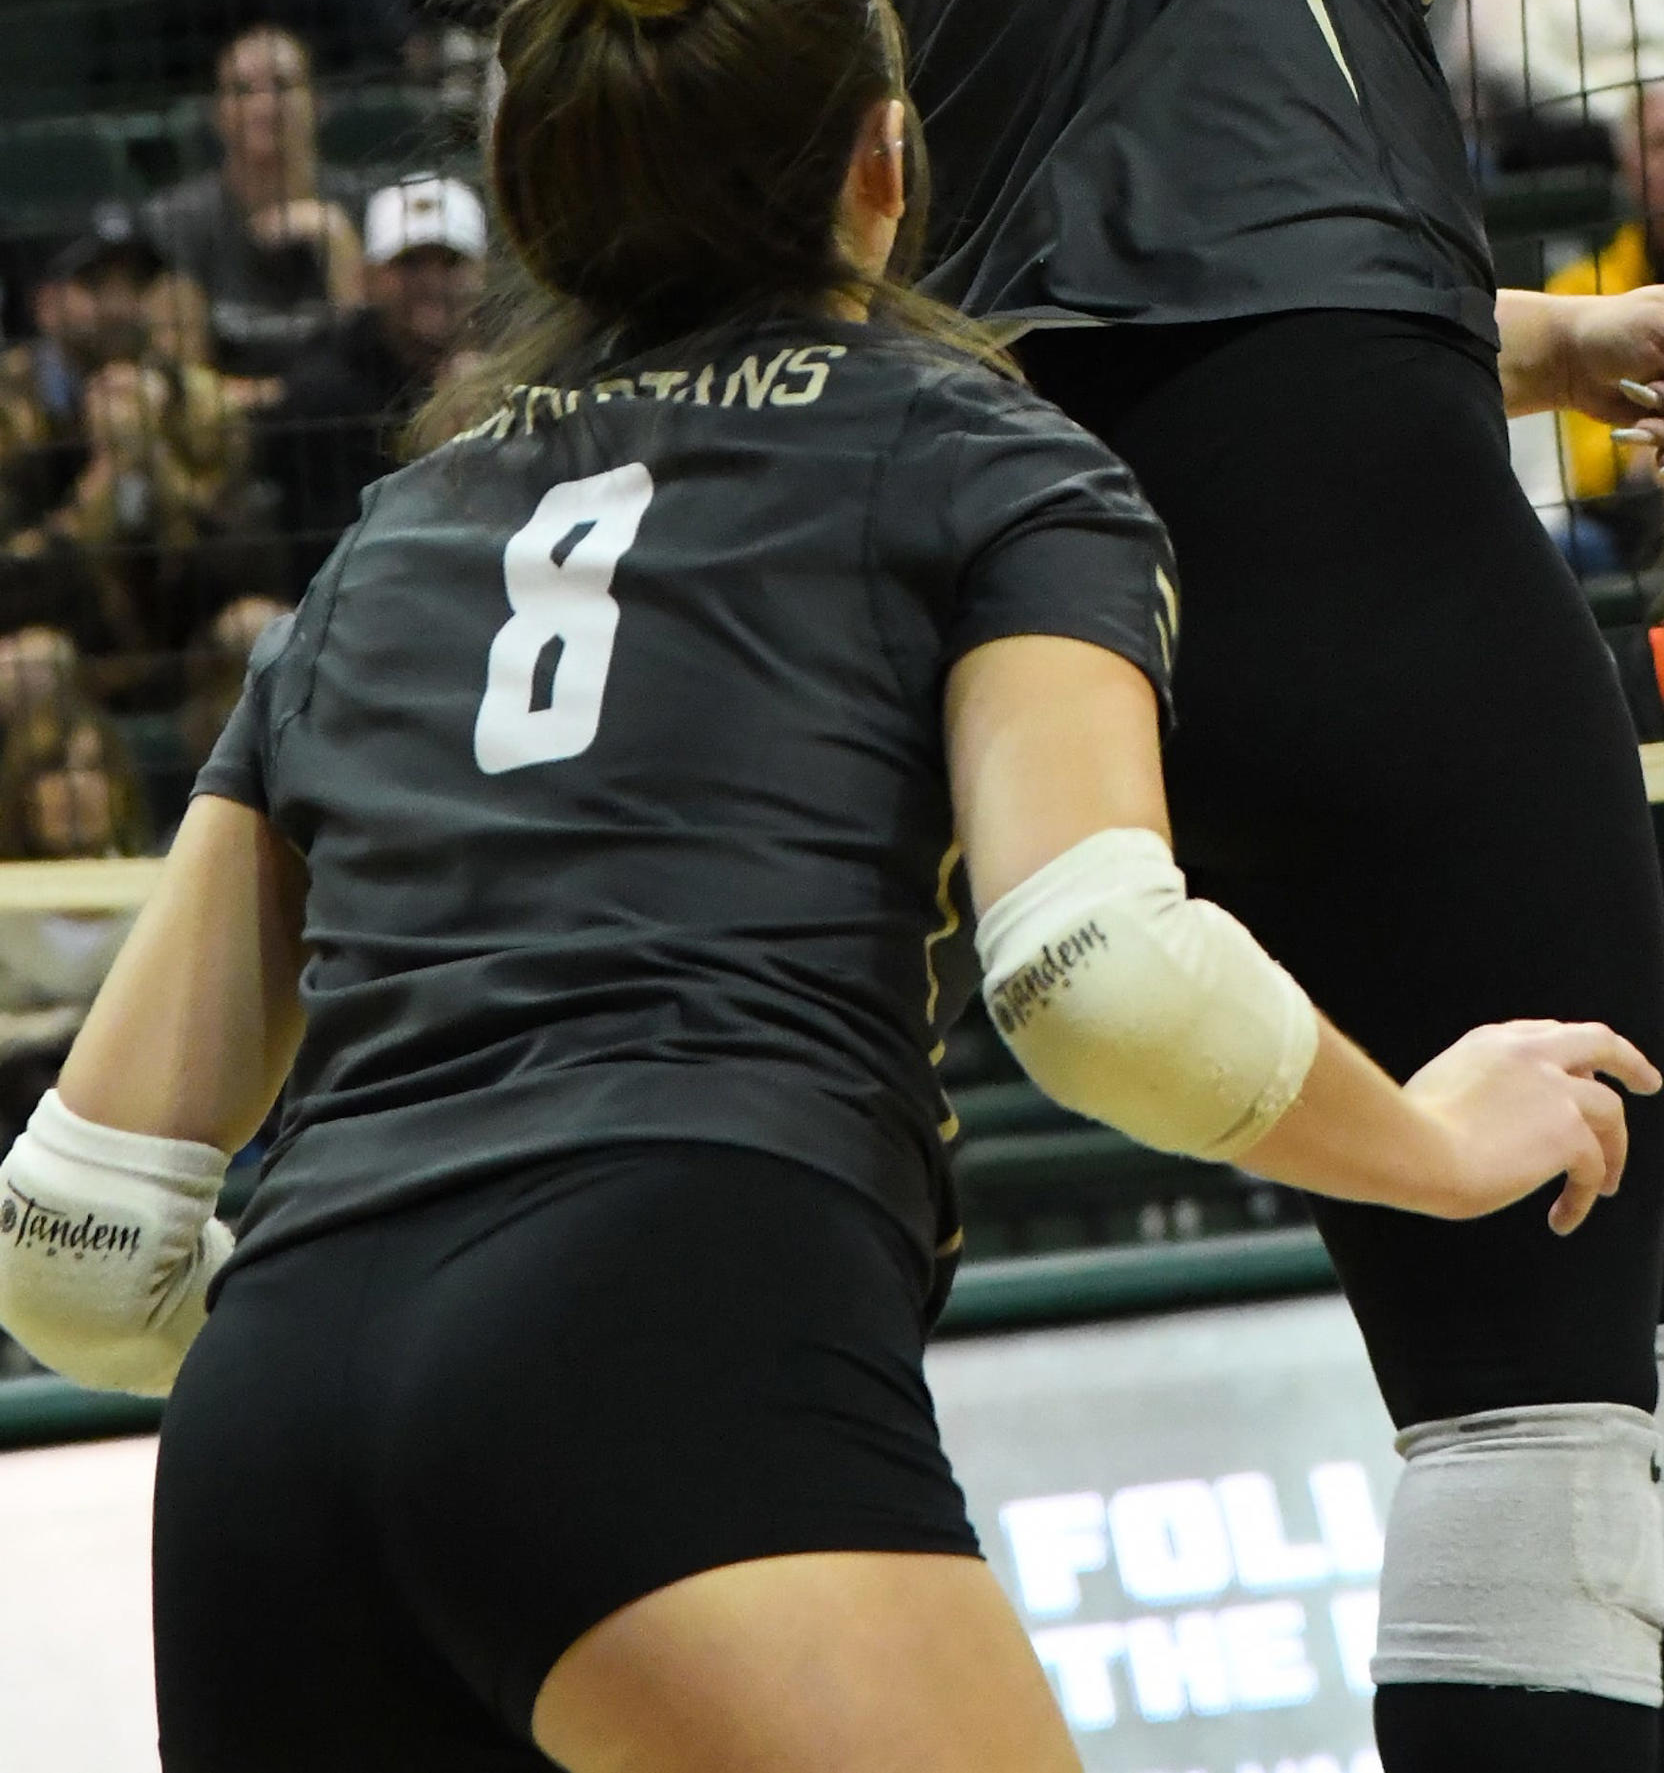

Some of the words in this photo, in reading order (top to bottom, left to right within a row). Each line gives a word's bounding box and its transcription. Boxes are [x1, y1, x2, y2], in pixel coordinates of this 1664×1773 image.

[474, 461, 655, 775] 8
[993, 919, 1108, 1027] Tandem
[8, 1180, 142, 1261] Tandem
[1028, 1600, 1320, 1734] THE
